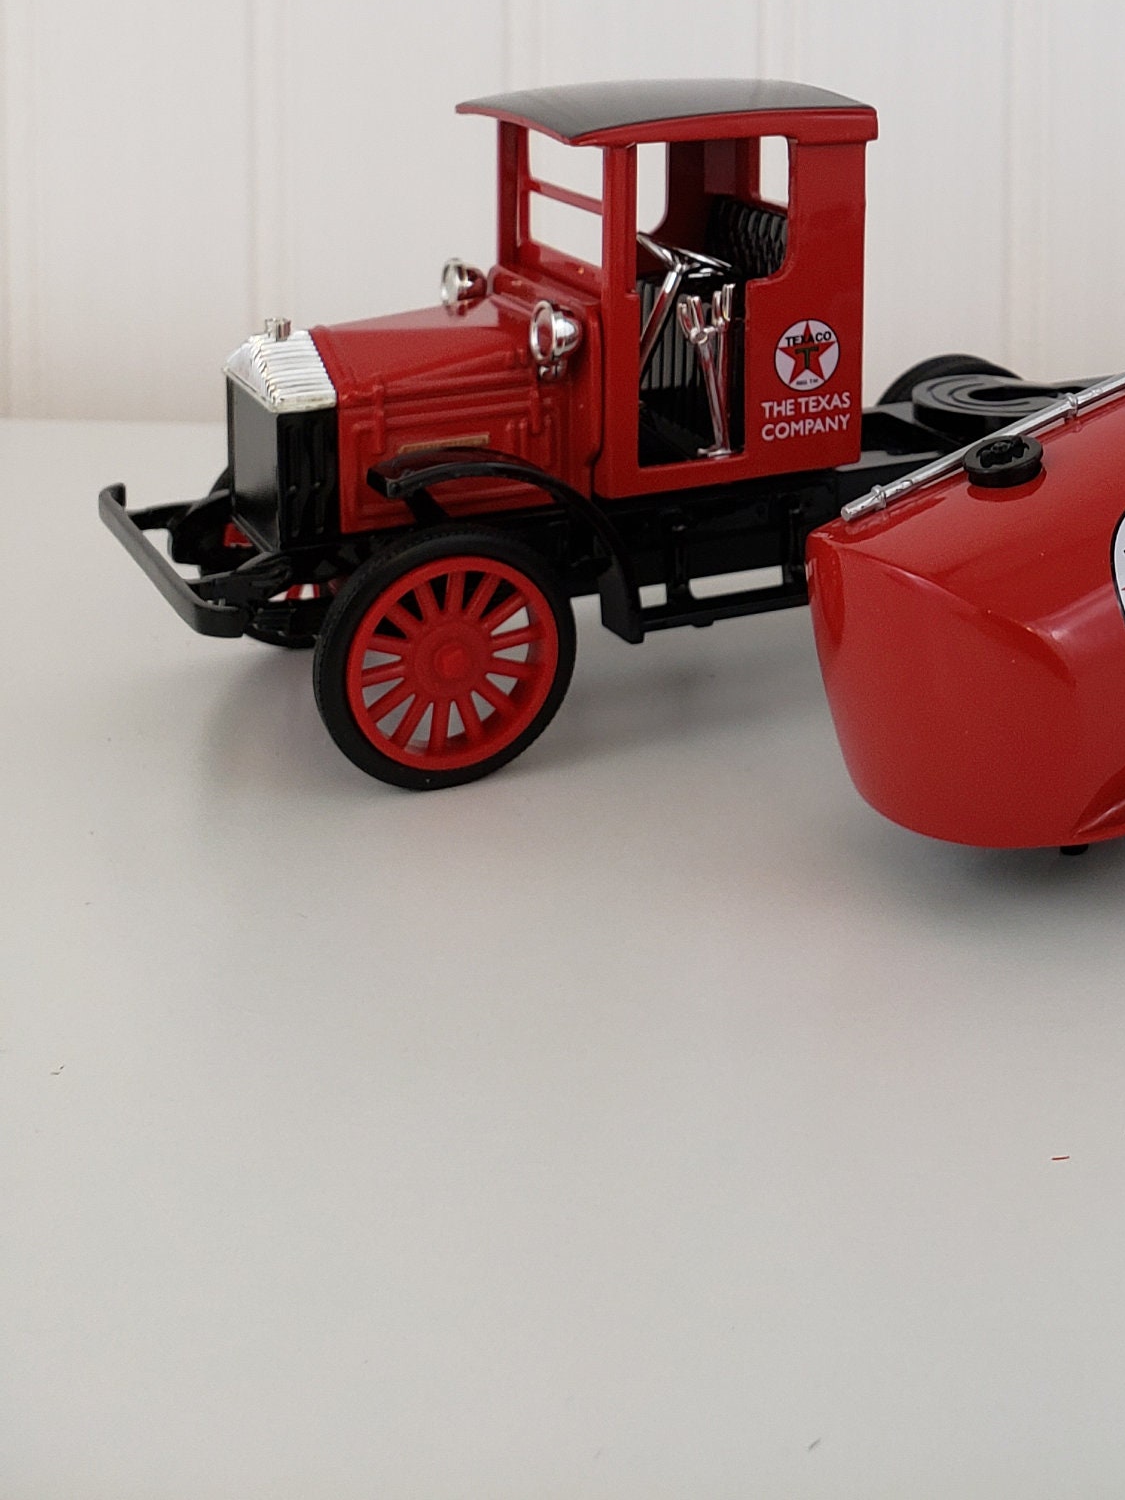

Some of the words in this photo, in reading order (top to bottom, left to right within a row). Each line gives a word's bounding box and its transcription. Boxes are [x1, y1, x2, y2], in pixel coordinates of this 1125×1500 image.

[785, 331, 832, 347] TEXACO
[795, 347, 819, 369] T
[761, 399, 795, 418] THE
[797, 392, 850, 413] TEXAS
[761, 413, 850, 441] COMPANY
